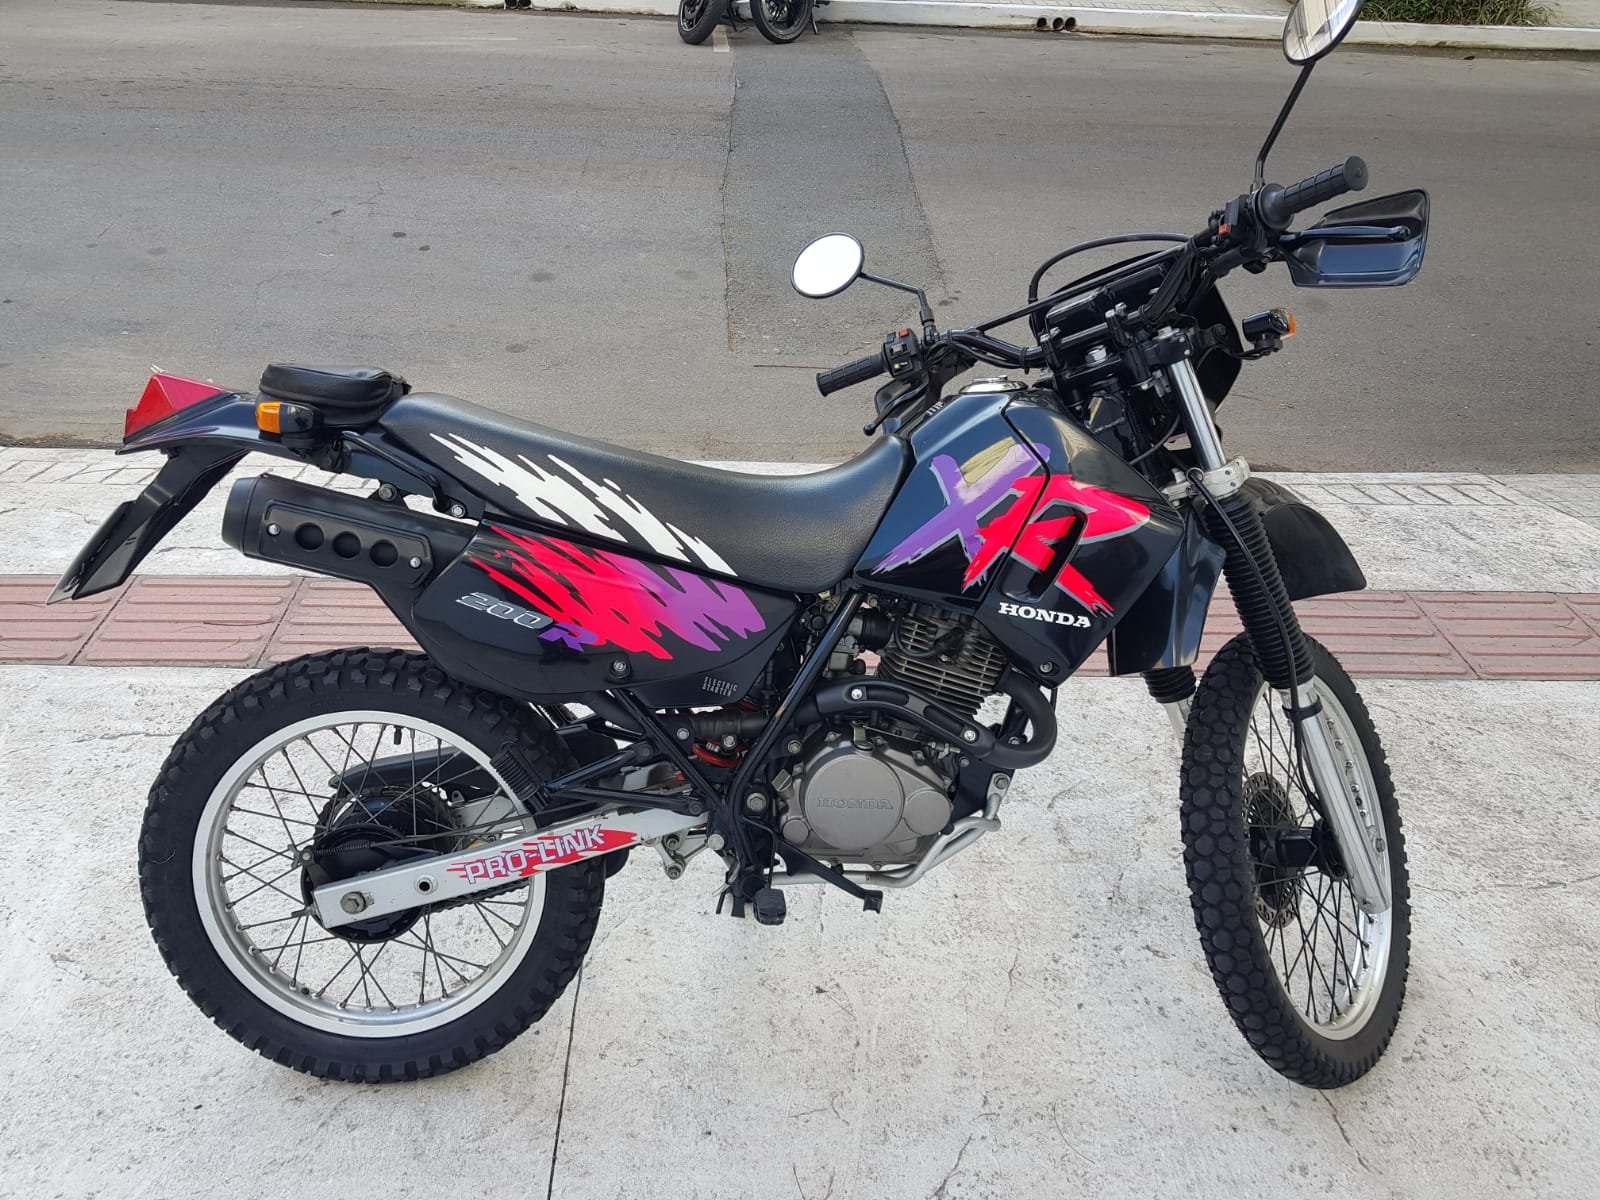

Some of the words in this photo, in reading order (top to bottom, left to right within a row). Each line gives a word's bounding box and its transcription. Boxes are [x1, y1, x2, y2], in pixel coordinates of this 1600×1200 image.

[871, 442, 1152, 618] XR
[998, 601, 1092, 629] HONDA
[816, 799, 894, 810] HONDA
[464, 824, 606, 885] PRO-LINK
